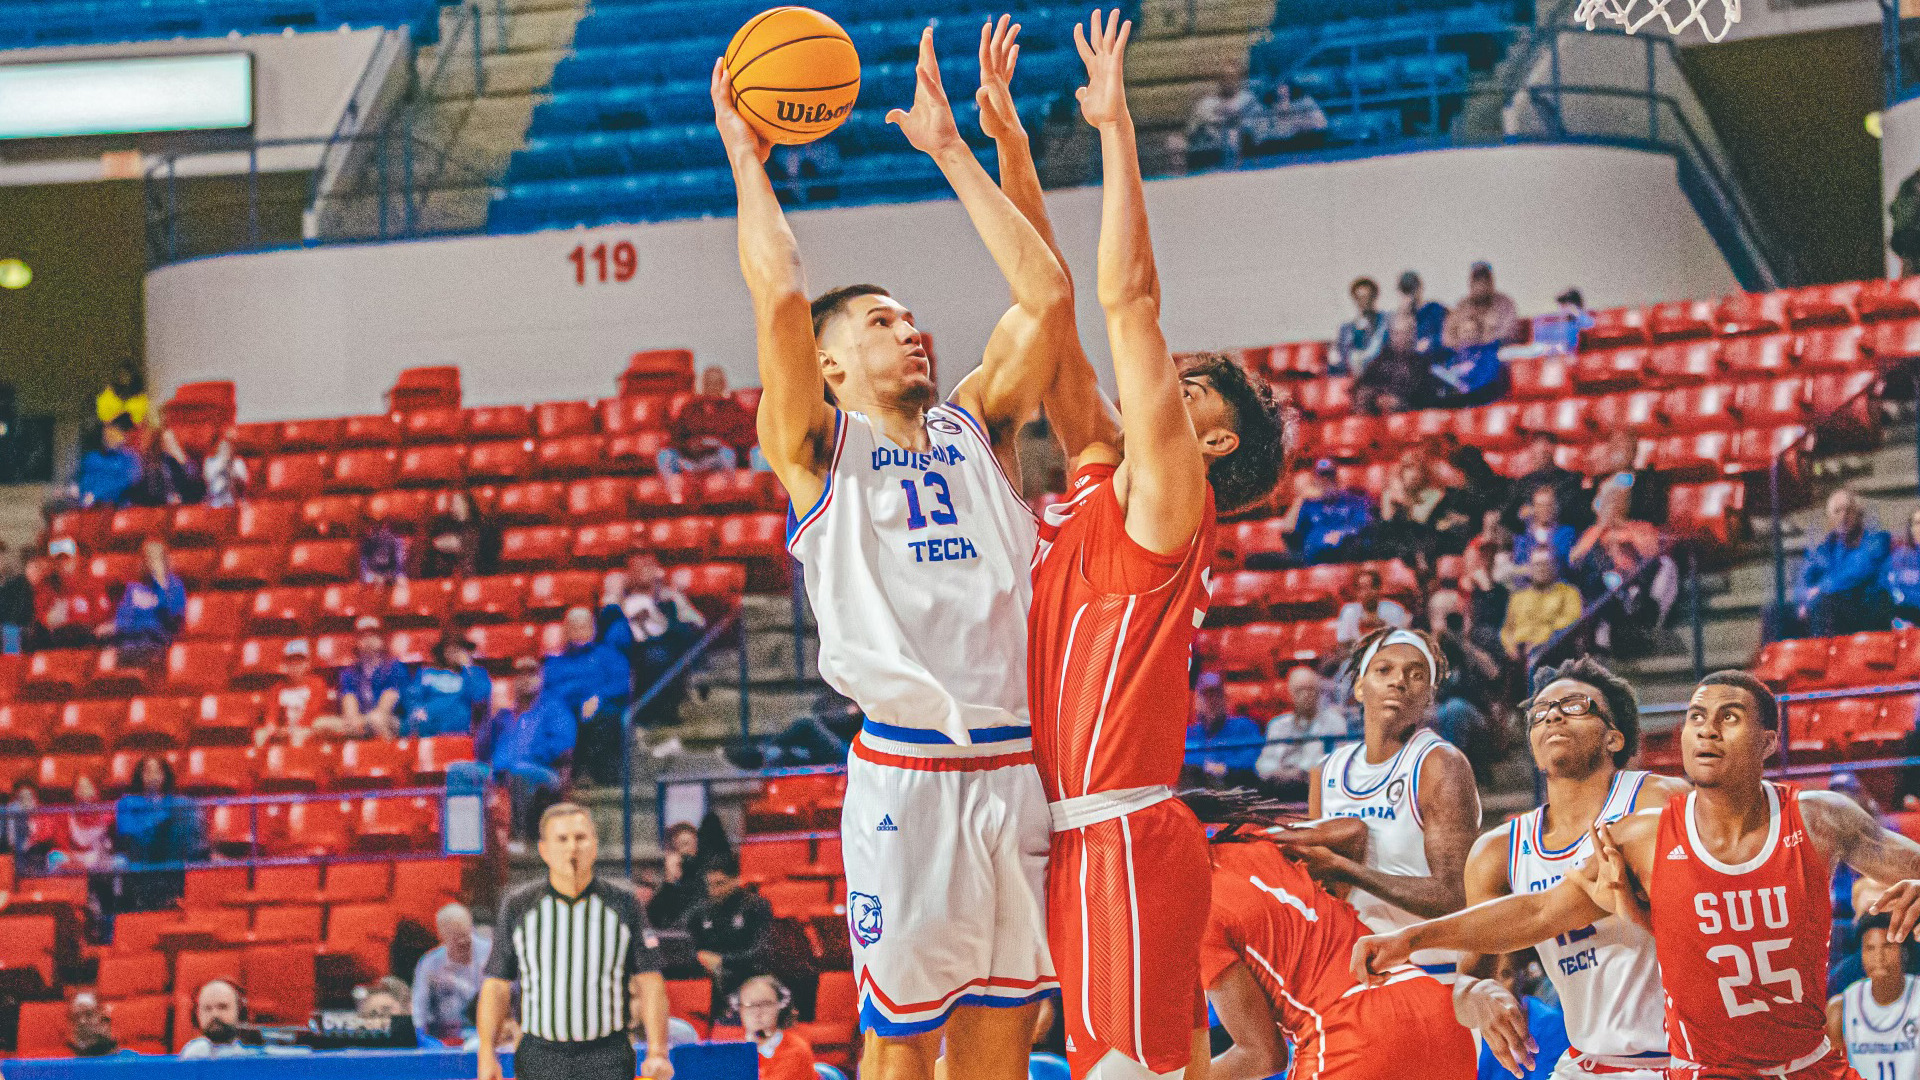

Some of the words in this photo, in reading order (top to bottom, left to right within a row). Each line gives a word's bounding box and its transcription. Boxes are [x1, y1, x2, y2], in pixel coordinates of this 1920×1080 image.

[567, 241, 637, 286] 119
[871, 444, 966, 471] LOUISA
[900, 471, 958, 530] 13
[908, 537, 978, 562] TECH
[1694, 886, 1789, 934] SUU
[1558, 947, 1598, 976] TECH
[1706, 938, 1804, 1018] 25
